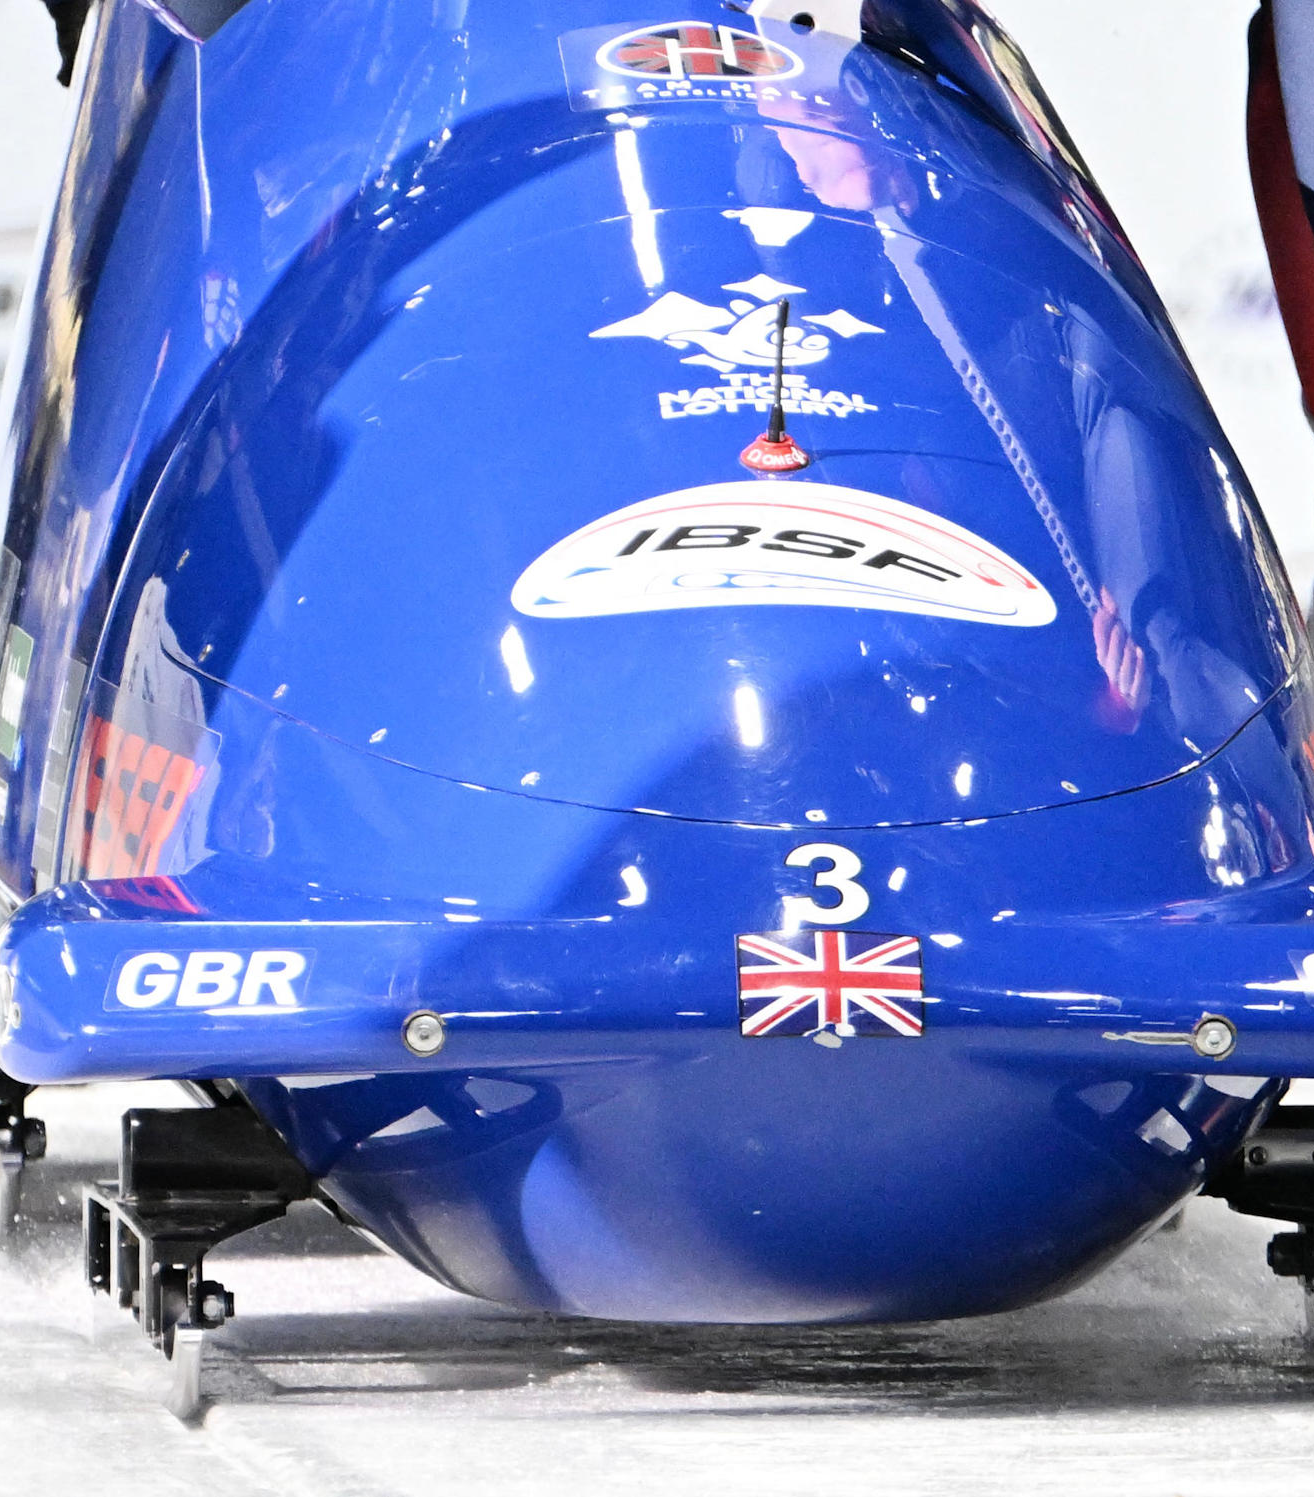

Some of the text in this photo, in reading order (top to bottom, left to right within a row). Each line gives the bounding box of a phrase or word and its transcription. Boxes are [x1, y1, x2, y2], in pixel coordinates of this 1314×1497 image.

[720, 372, 810, 389] THE
[615, 524, 962, 582] IBSF
[784, 842, 870, 925] 3
[116, 950, 306, 1009] GBR
